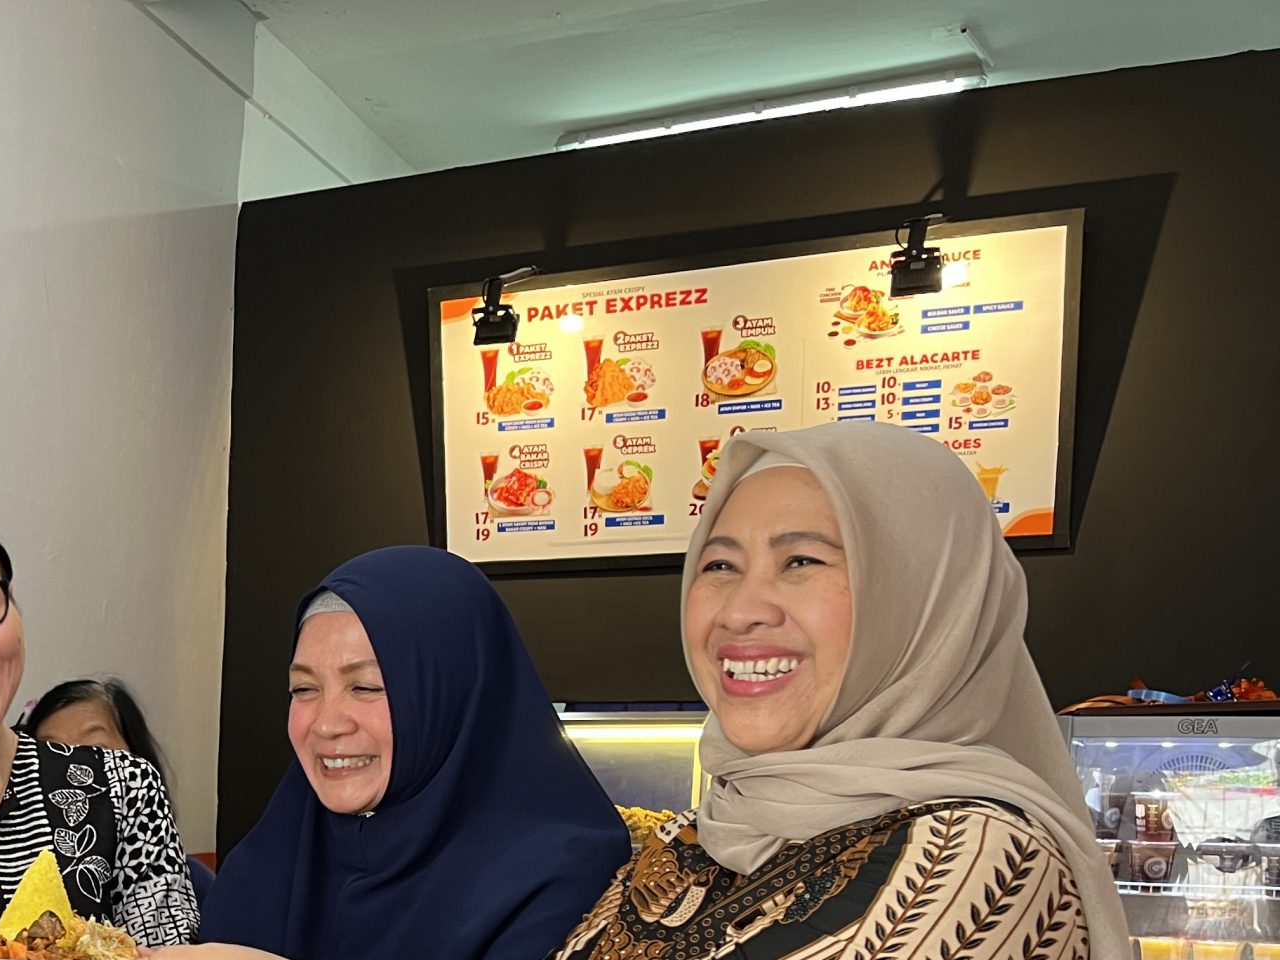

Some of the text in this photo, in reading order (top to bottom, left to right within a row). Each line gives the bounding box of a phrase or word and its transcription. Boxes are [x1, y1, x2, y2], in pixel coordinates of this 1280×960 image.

[606, 288, 623, 296] AYAM
[624, 286, 646, 295] CRISPY
[527, 288, 708, 323] PAKET EXPREZZ
[735, 317, 744, 328] 3
[745, 318, 772, 328] AYAM
[624, 332, 653, 342] PAKET
[742, 327, 776, 337] EMPUK
[616, 333, 624, 344] 2
[519, 343, 547, 353] PAKET
[619, 342, 658, 352] EXPREZZ
[514, 352, 552, 362] EXPREZZ
[856, 350, 980, 370] BEZT ALACARTE
[816, 381, 831, 394] 10
[882, 376, 897, 389] 10
[816, 397, 830, 410] 13
[881, 392, 896, 405] 10
[887, 410, 894, 419] 5
[948, 416, 963, 430] 15
[615, 437, 624, 447] 5
[627, 437, 652, 446] AYAM
[512, 447, 520, 458] 4
[522, 445, 546, 453] AYAM
[521, 452, 548, 461] BAKAR
[520, 460, 549, 469] CRISPY
[476, 528, 490, 541] 19
[583, 523, 598, 536] 19
[1177, 718, 1218, 735] GEA
